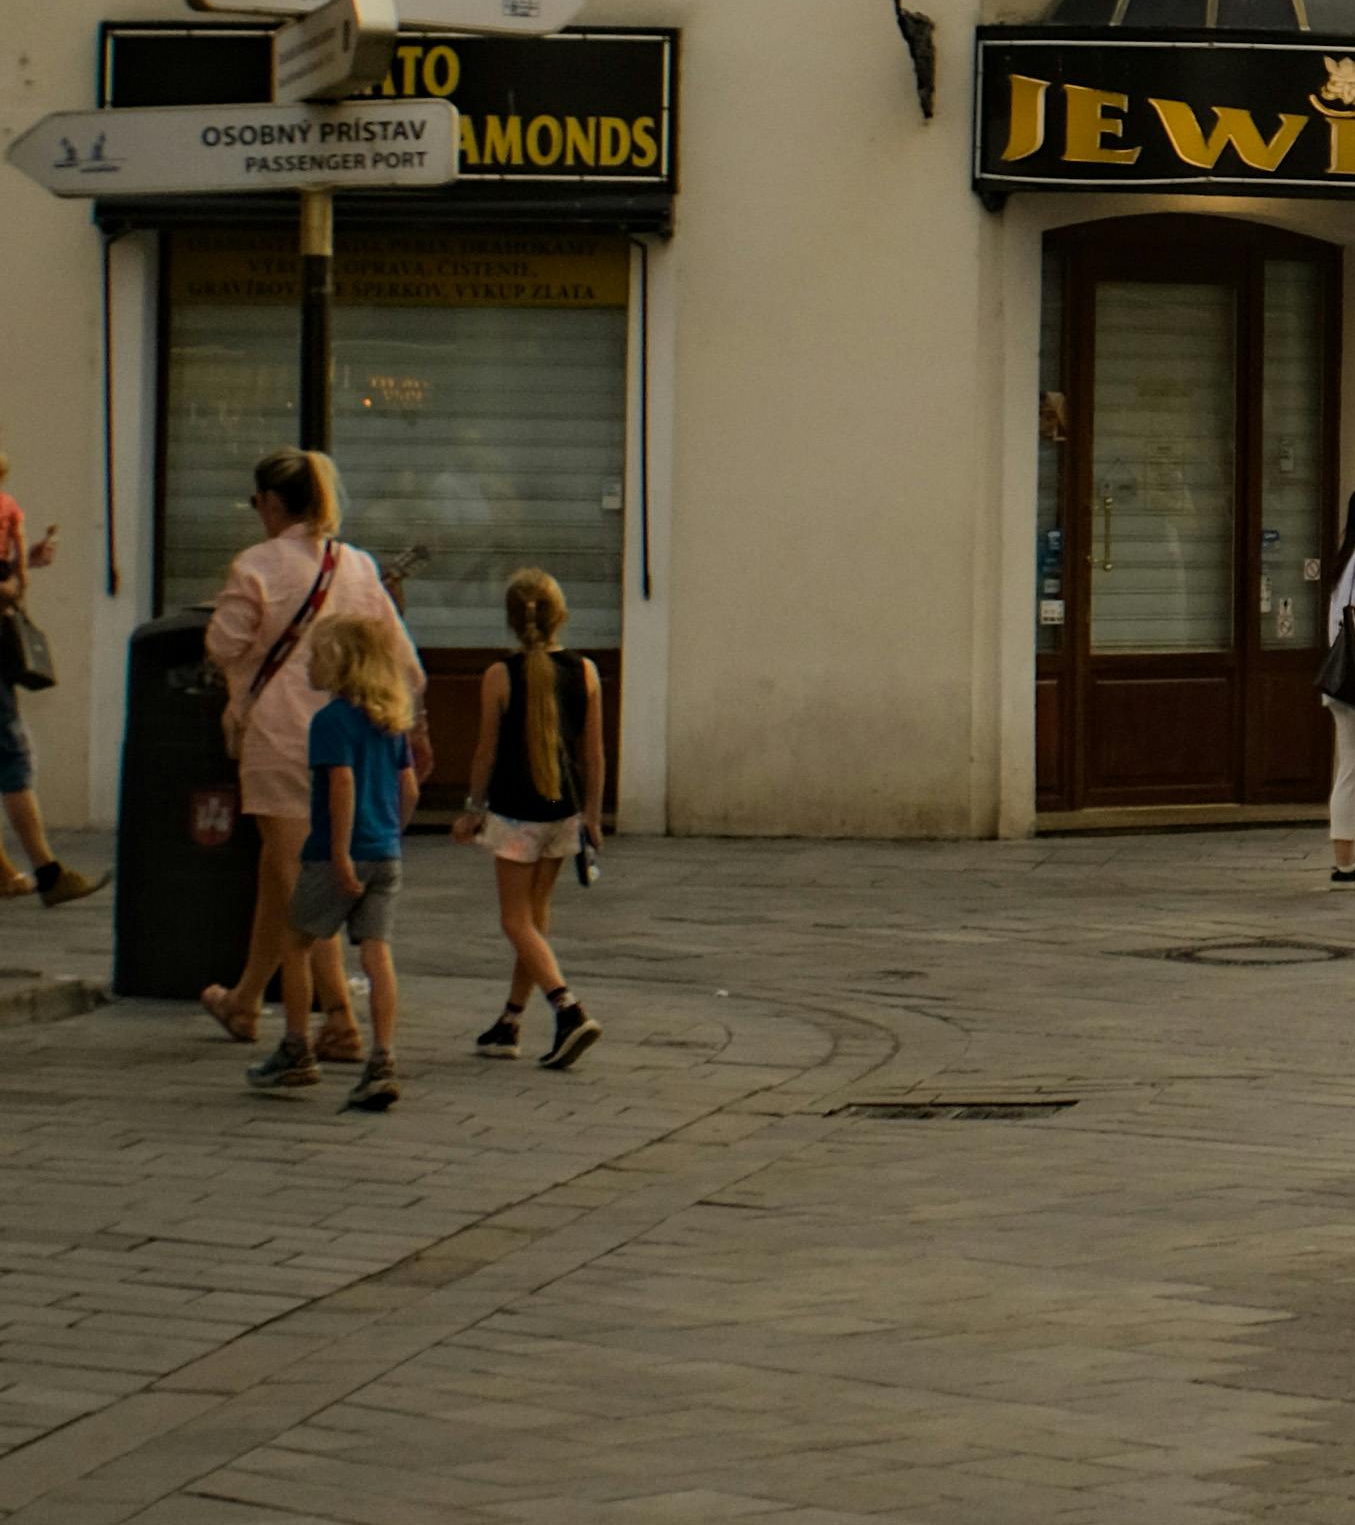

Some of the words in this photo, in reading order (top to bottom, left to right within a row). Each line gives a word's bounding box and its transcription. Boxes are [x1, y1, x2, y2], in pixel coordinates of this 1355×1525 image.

[202, 118, 311, 147] OSOBNÝ
[319, 116, 427, 143] PRÍSTAV
[459, 114, 657, 167] AMONDS
[246, 153, 365, 173] PASSENGER
[372, 151, 427, 169] PORT
